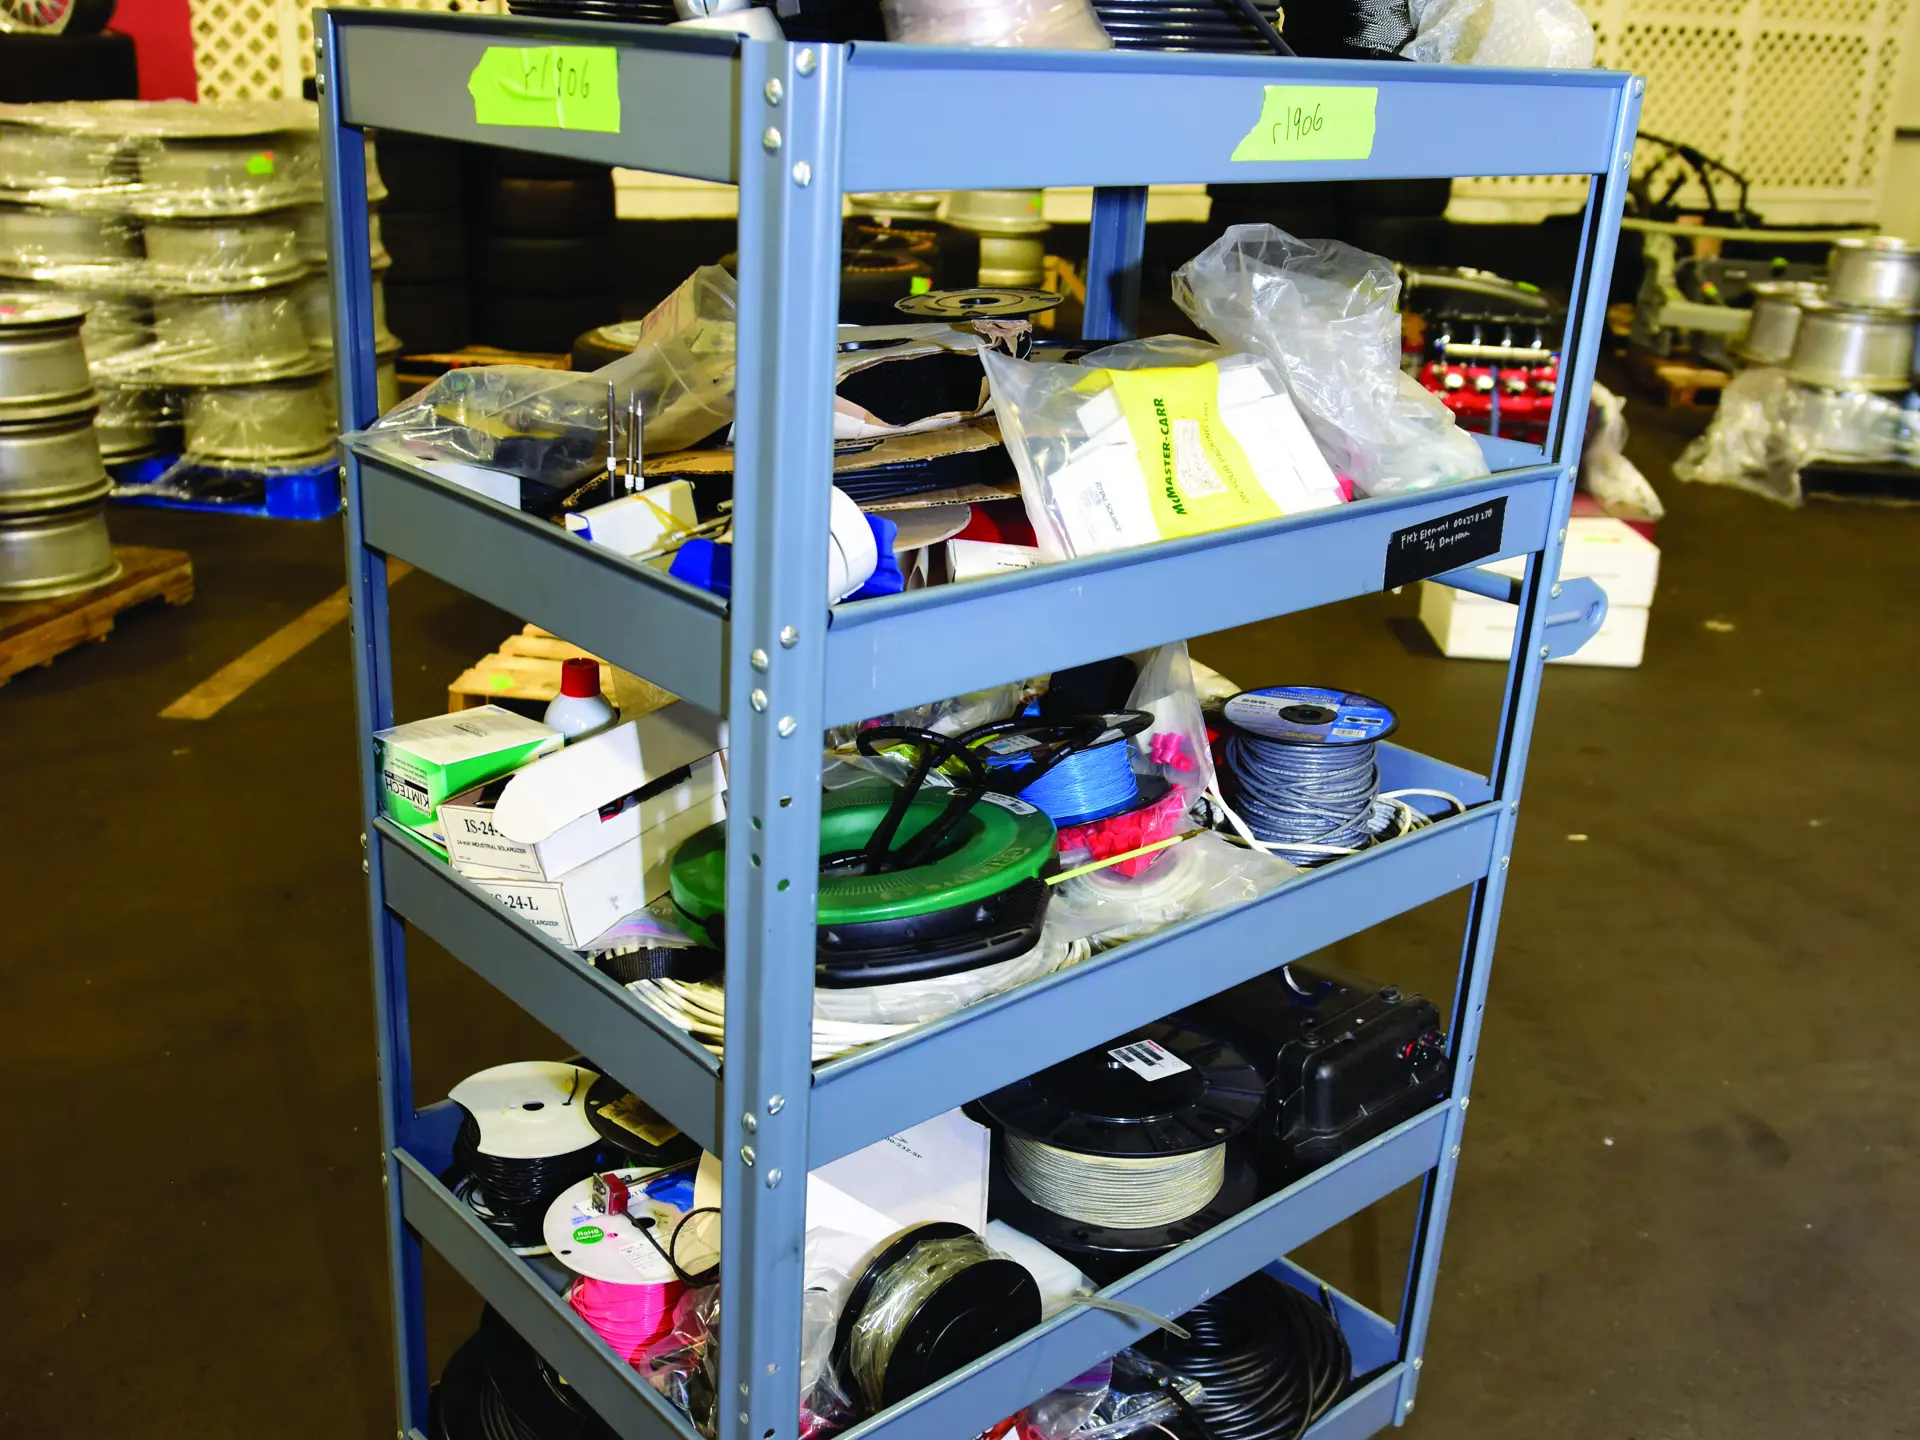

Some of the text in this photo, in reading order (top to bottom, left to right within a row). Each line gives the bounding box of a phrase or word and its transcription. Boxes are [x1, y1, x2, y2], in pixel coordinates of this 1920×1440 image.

[1272, 103, 1324, 145] r1906
[1203, 424, 1227, 464] PACKING
[384, 777, 430, 809] KIMTECH
[463, 819, 506, 838] IS-24-
[490, 893, 539, 911] S-24-L
